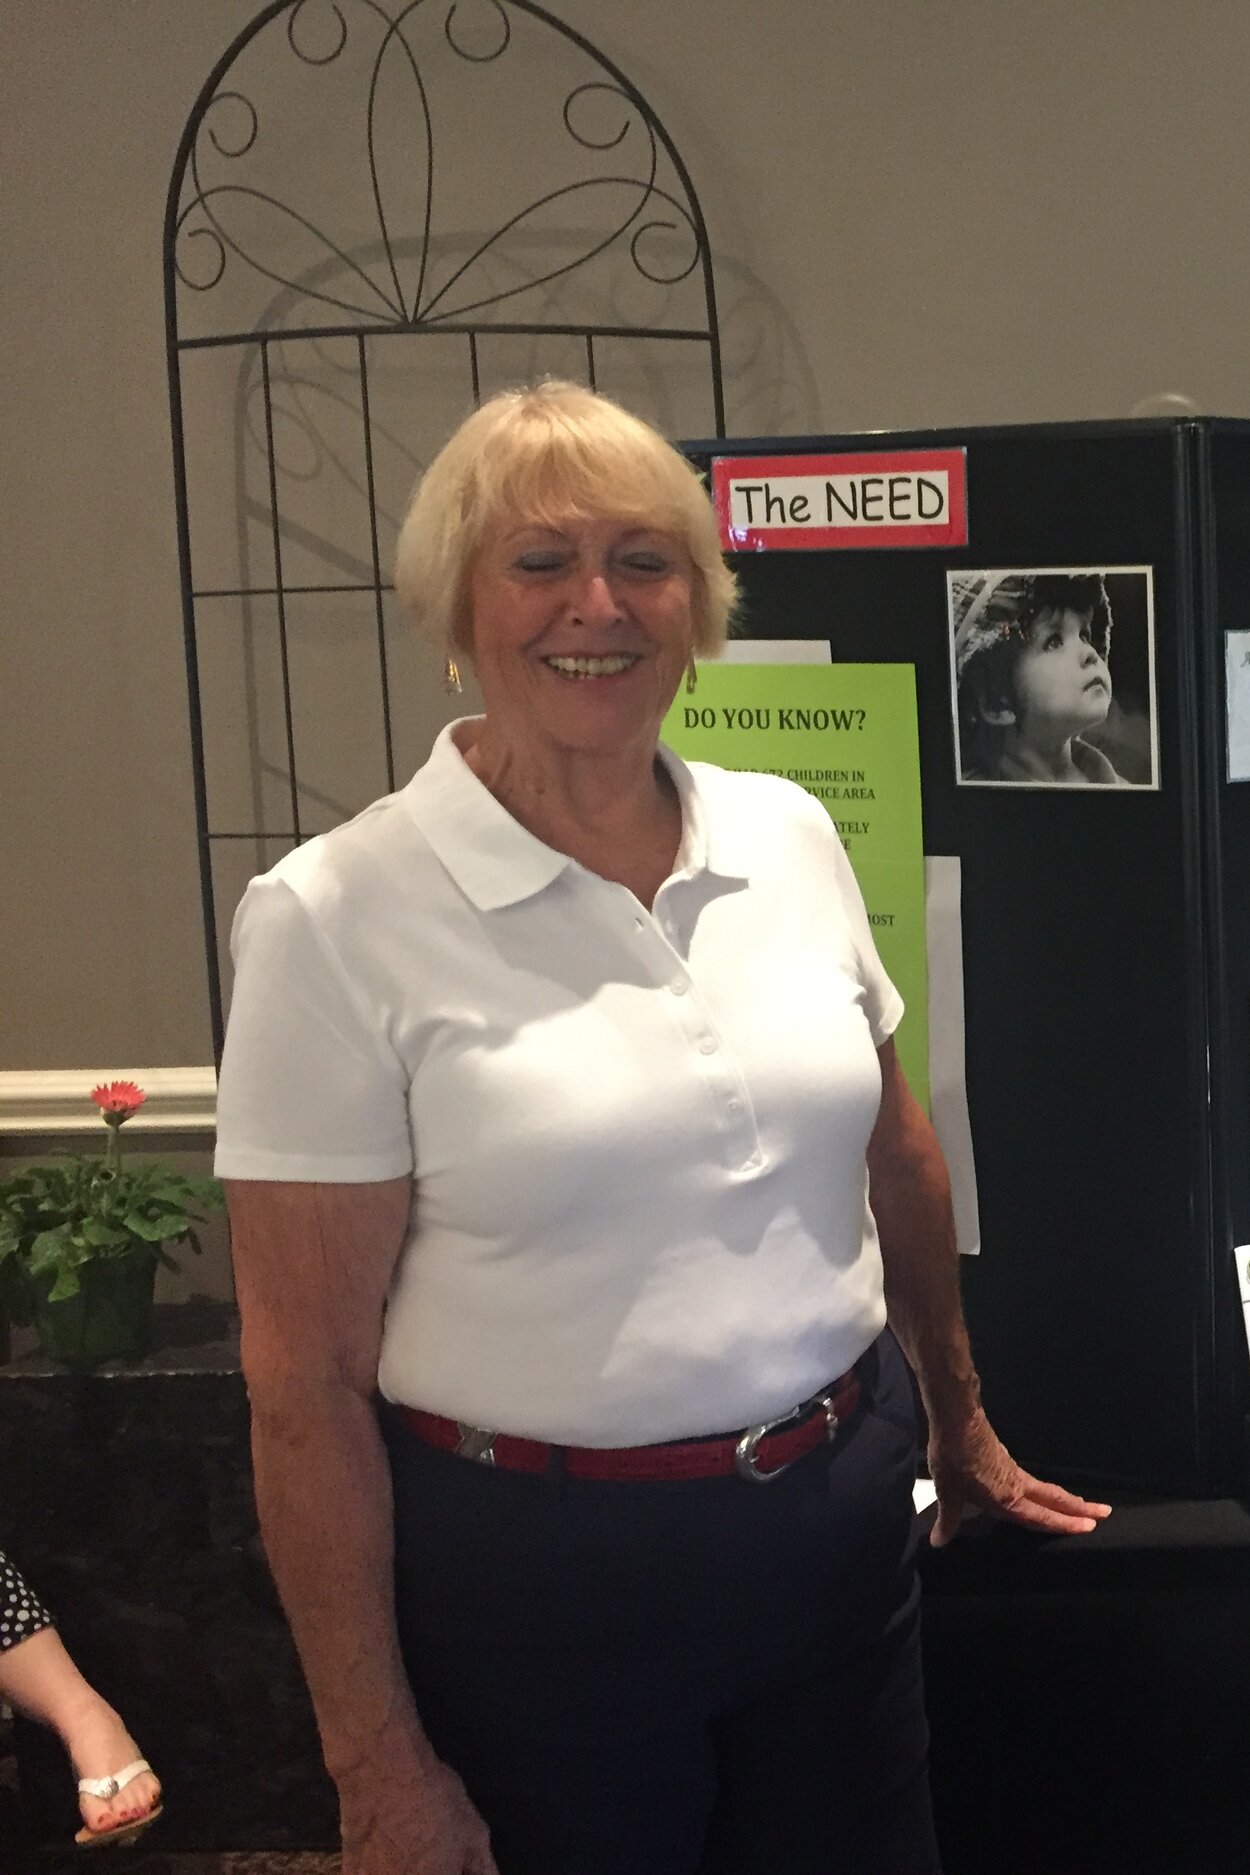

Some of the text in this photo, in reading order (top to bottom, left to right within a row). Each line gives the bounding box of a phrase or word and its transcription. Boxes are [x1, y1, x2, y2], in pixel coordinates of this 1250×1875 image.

[735, 477, 944, 524] The NEED
[1240, 650, 1250, 668] A
[684, 708, 866, 731] DO YOU KNOW?
[787, 769, 849, 782] CHILDREN
[852, 770, 865, 782] IN
[843, 788, 875, 800] AREA
[867, 914, 895, 926] OST
